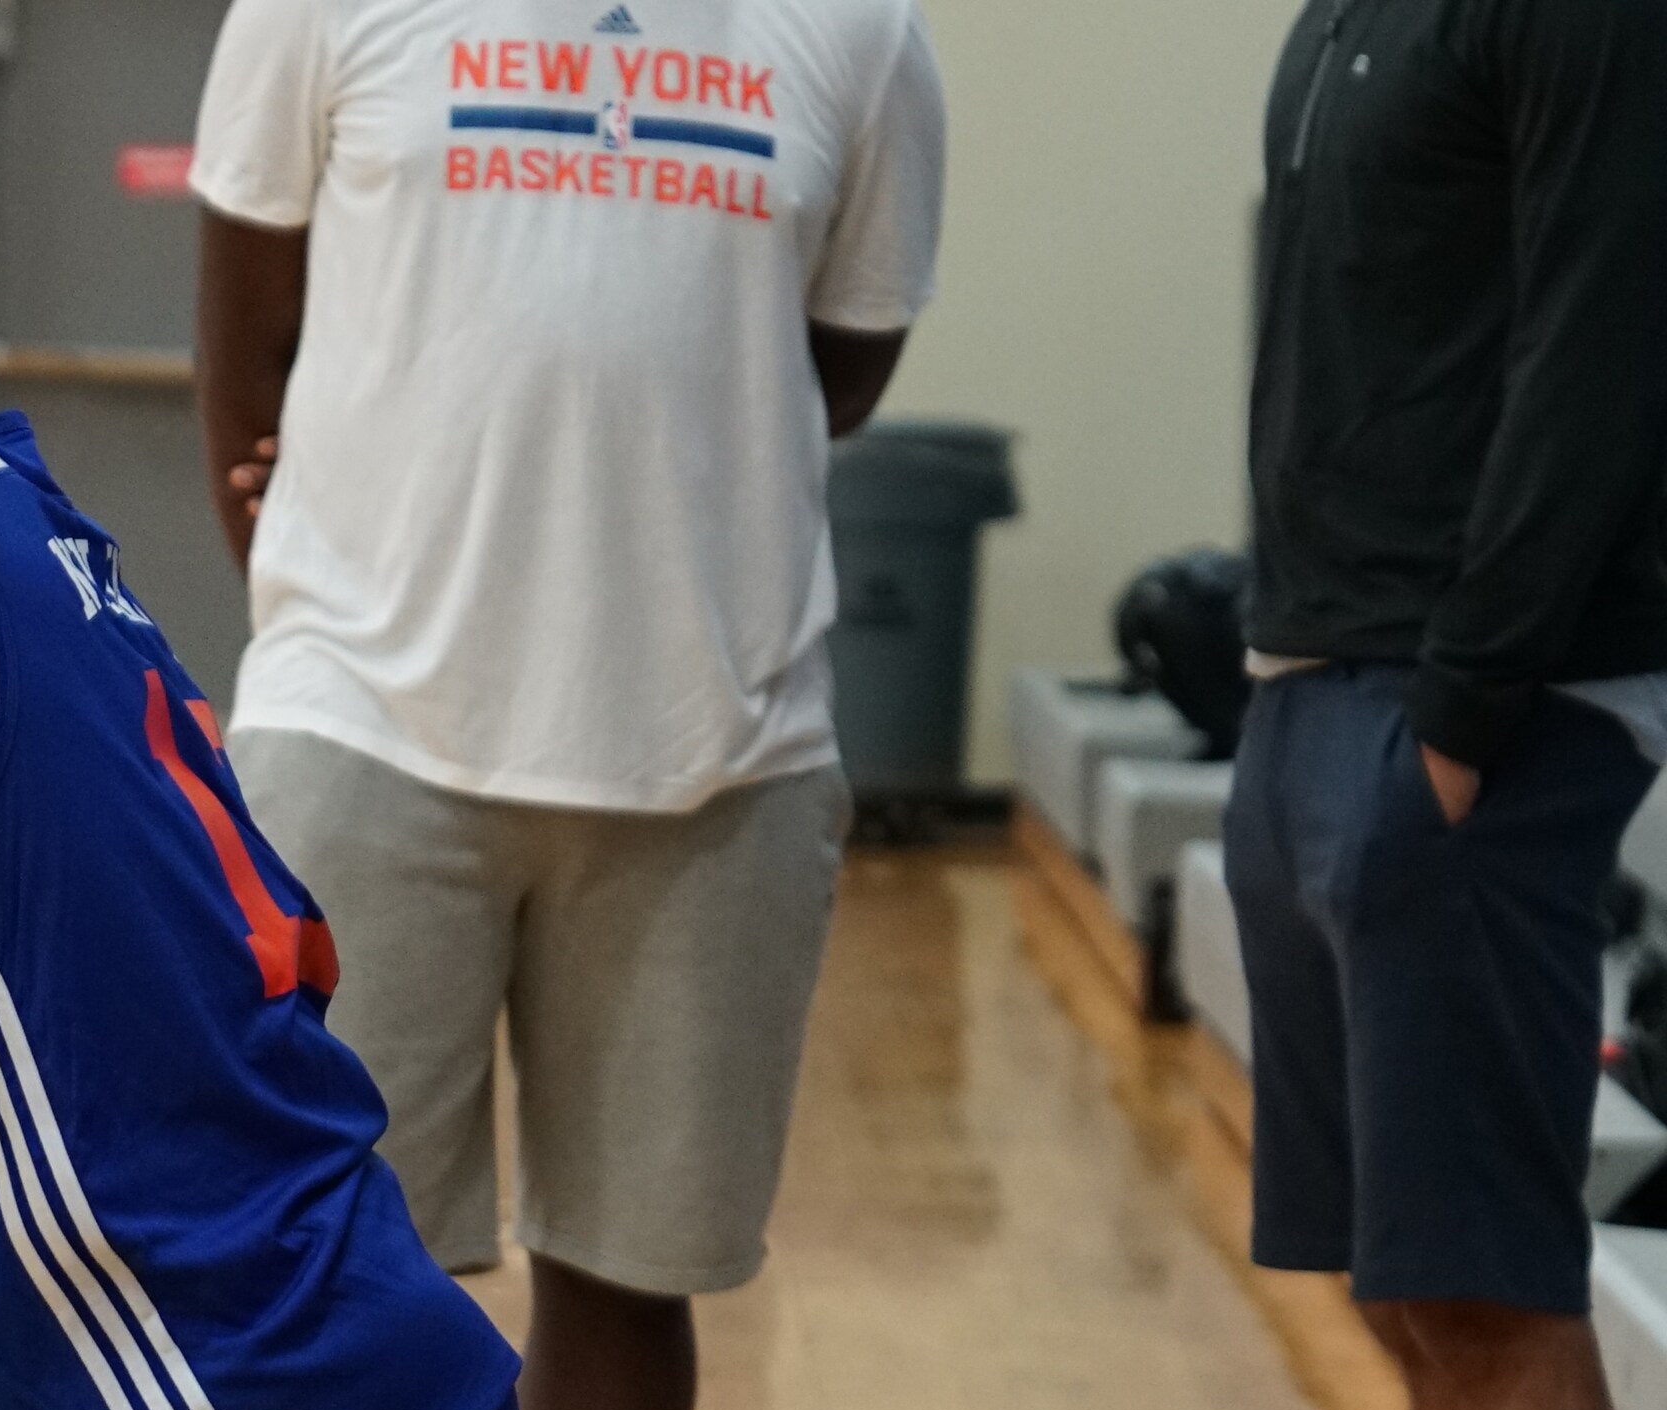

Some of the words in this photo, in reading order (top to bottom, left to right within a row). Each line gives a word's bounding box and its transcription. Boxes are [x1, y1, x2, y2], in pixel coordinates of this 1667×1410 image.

[450, 40, 592, 95] NEW
[612, 47, 775, 119] YORK
[445, 145, 773, 220] BASKETBALL
